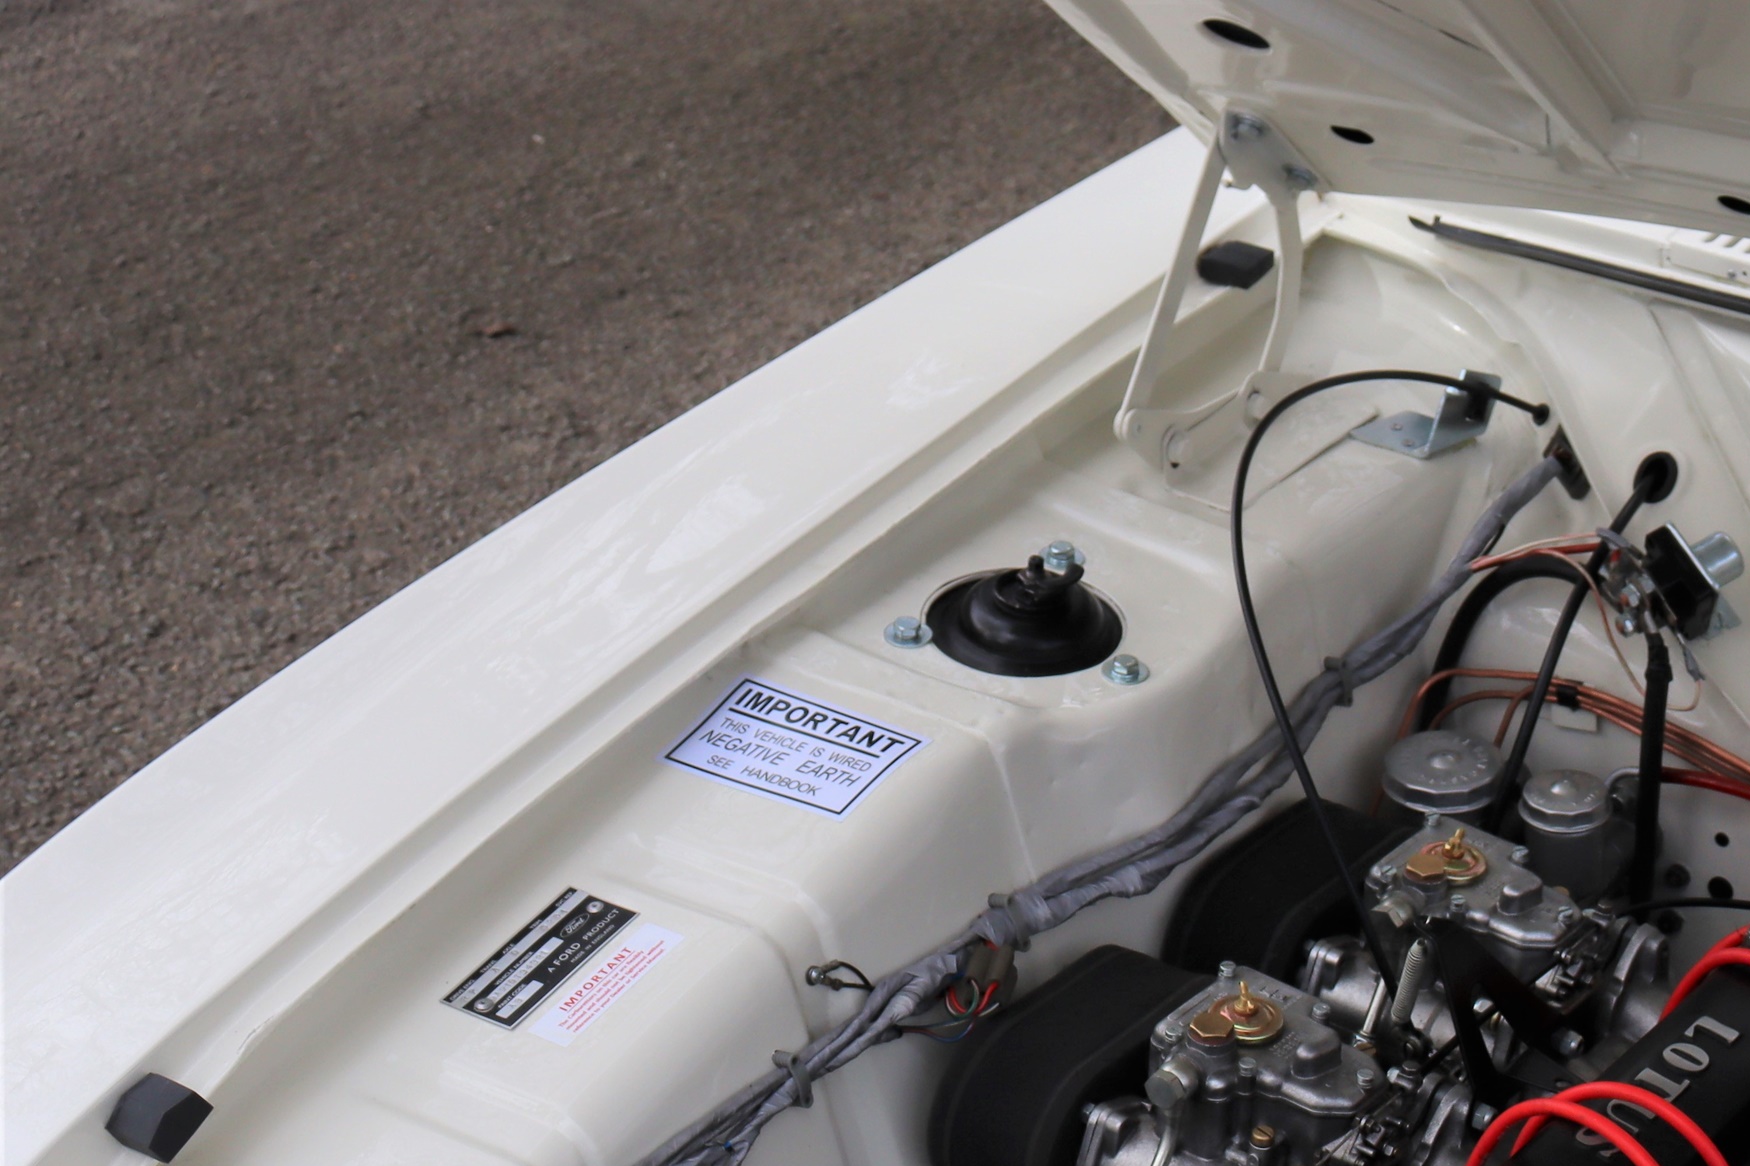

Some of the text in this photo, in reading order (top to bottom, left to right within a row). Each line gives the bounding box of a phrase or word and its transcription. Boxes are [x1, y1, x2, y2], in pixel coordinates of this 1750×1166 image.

[720, 718, 872, 772] THIS VEHICLE IS WIRED
[735, 688, 904, 754] IMPORTANT
[699, 730, 860, 787] NEGATIVE EARTH
[707, 755, 820, 796] SEE HANDBOOK
[553, 942, 581, 966] FORD
[582, 909, 619, 941] PRODUCT
[565, 918, 584, 934] Ford
[571, 951, 585, 963] MADE
[592, 924, 615, 944] ENGLAND
[559, 946, 632, 1012] IMPORTANT
